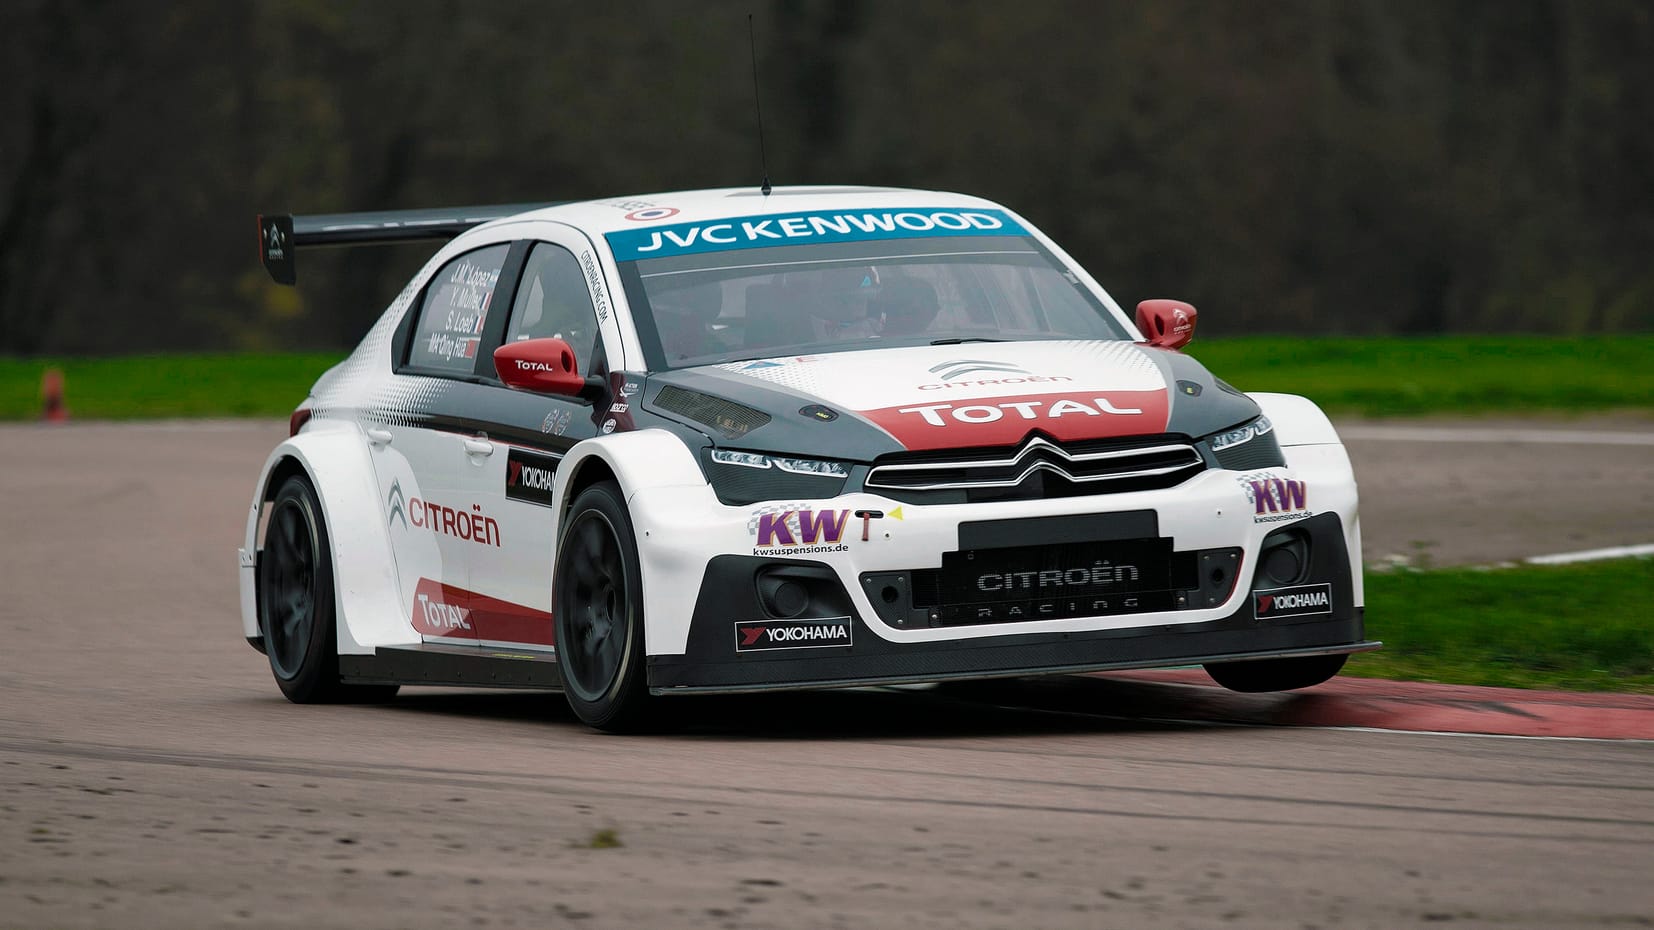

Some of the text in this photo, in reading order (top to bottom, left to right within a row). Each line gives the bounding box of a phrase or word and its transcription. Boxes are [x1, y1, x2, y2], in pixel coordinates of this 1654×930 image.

[454, 312, 474, 334] Loeb
[898, 397, 1143, 427] TOTAL
[521, 465, 555, 491] YOKOHA
[1248, 478, 1307, 515] KW
[756, 508, 852, 547] KW
[753, 543, 849, 557] kwsuspensions.de
[1272, 591, 1329, 610] YOKOHAMA
[766, 624, 848, 642] YOKOHAMA
